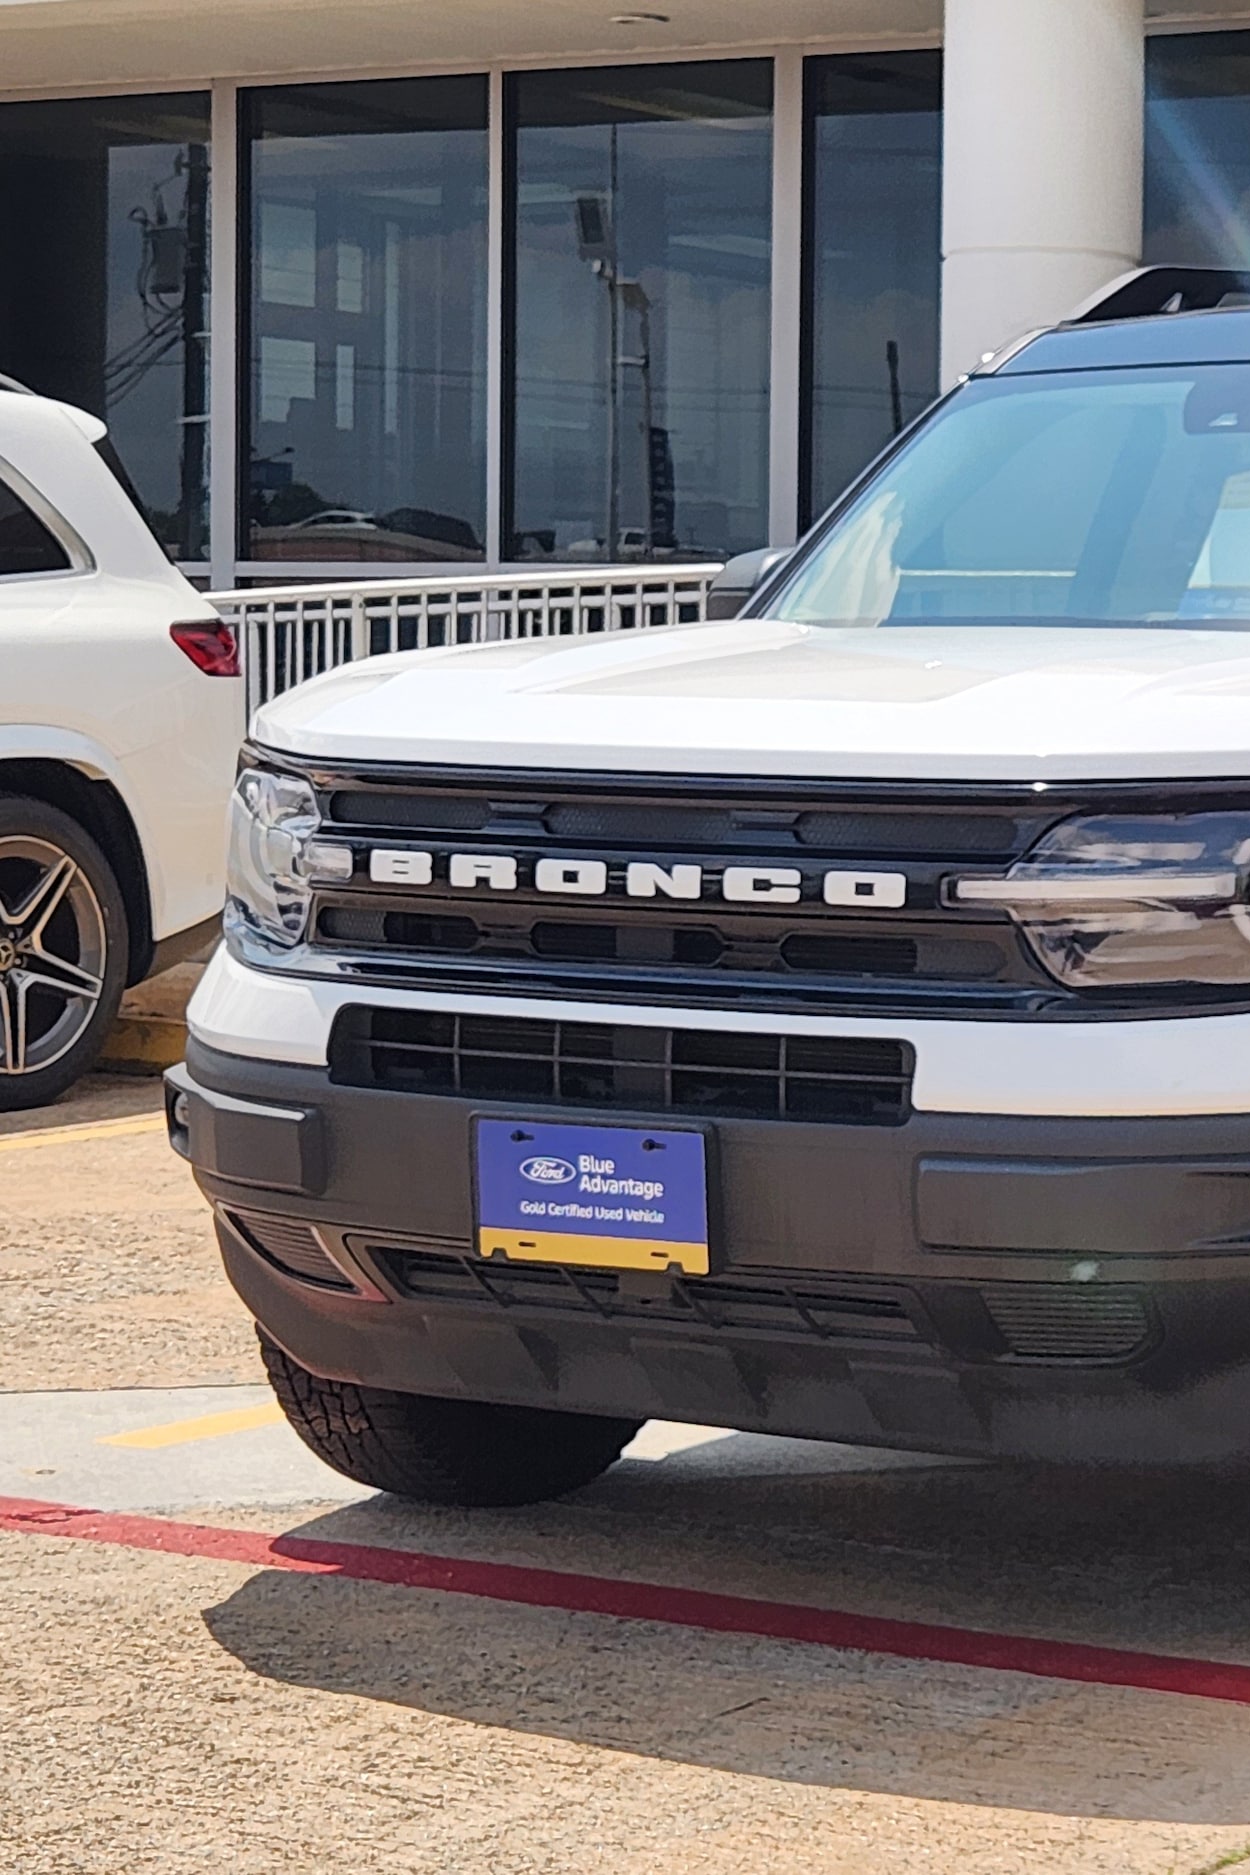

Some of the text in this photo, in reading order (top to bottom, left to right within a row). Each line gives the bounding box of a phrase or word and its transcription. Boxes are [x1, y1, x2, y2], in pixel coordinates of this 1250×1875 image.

[369, 848, 907, 908] BRONCO
[529, 1159, 566, 1181] Ford
[578, 1154, 615, 1175] Blue
[579, 1175, 665, 1200] Advantage
[520, 1200, 665, 1224] Gold Certified Used Vehicle
